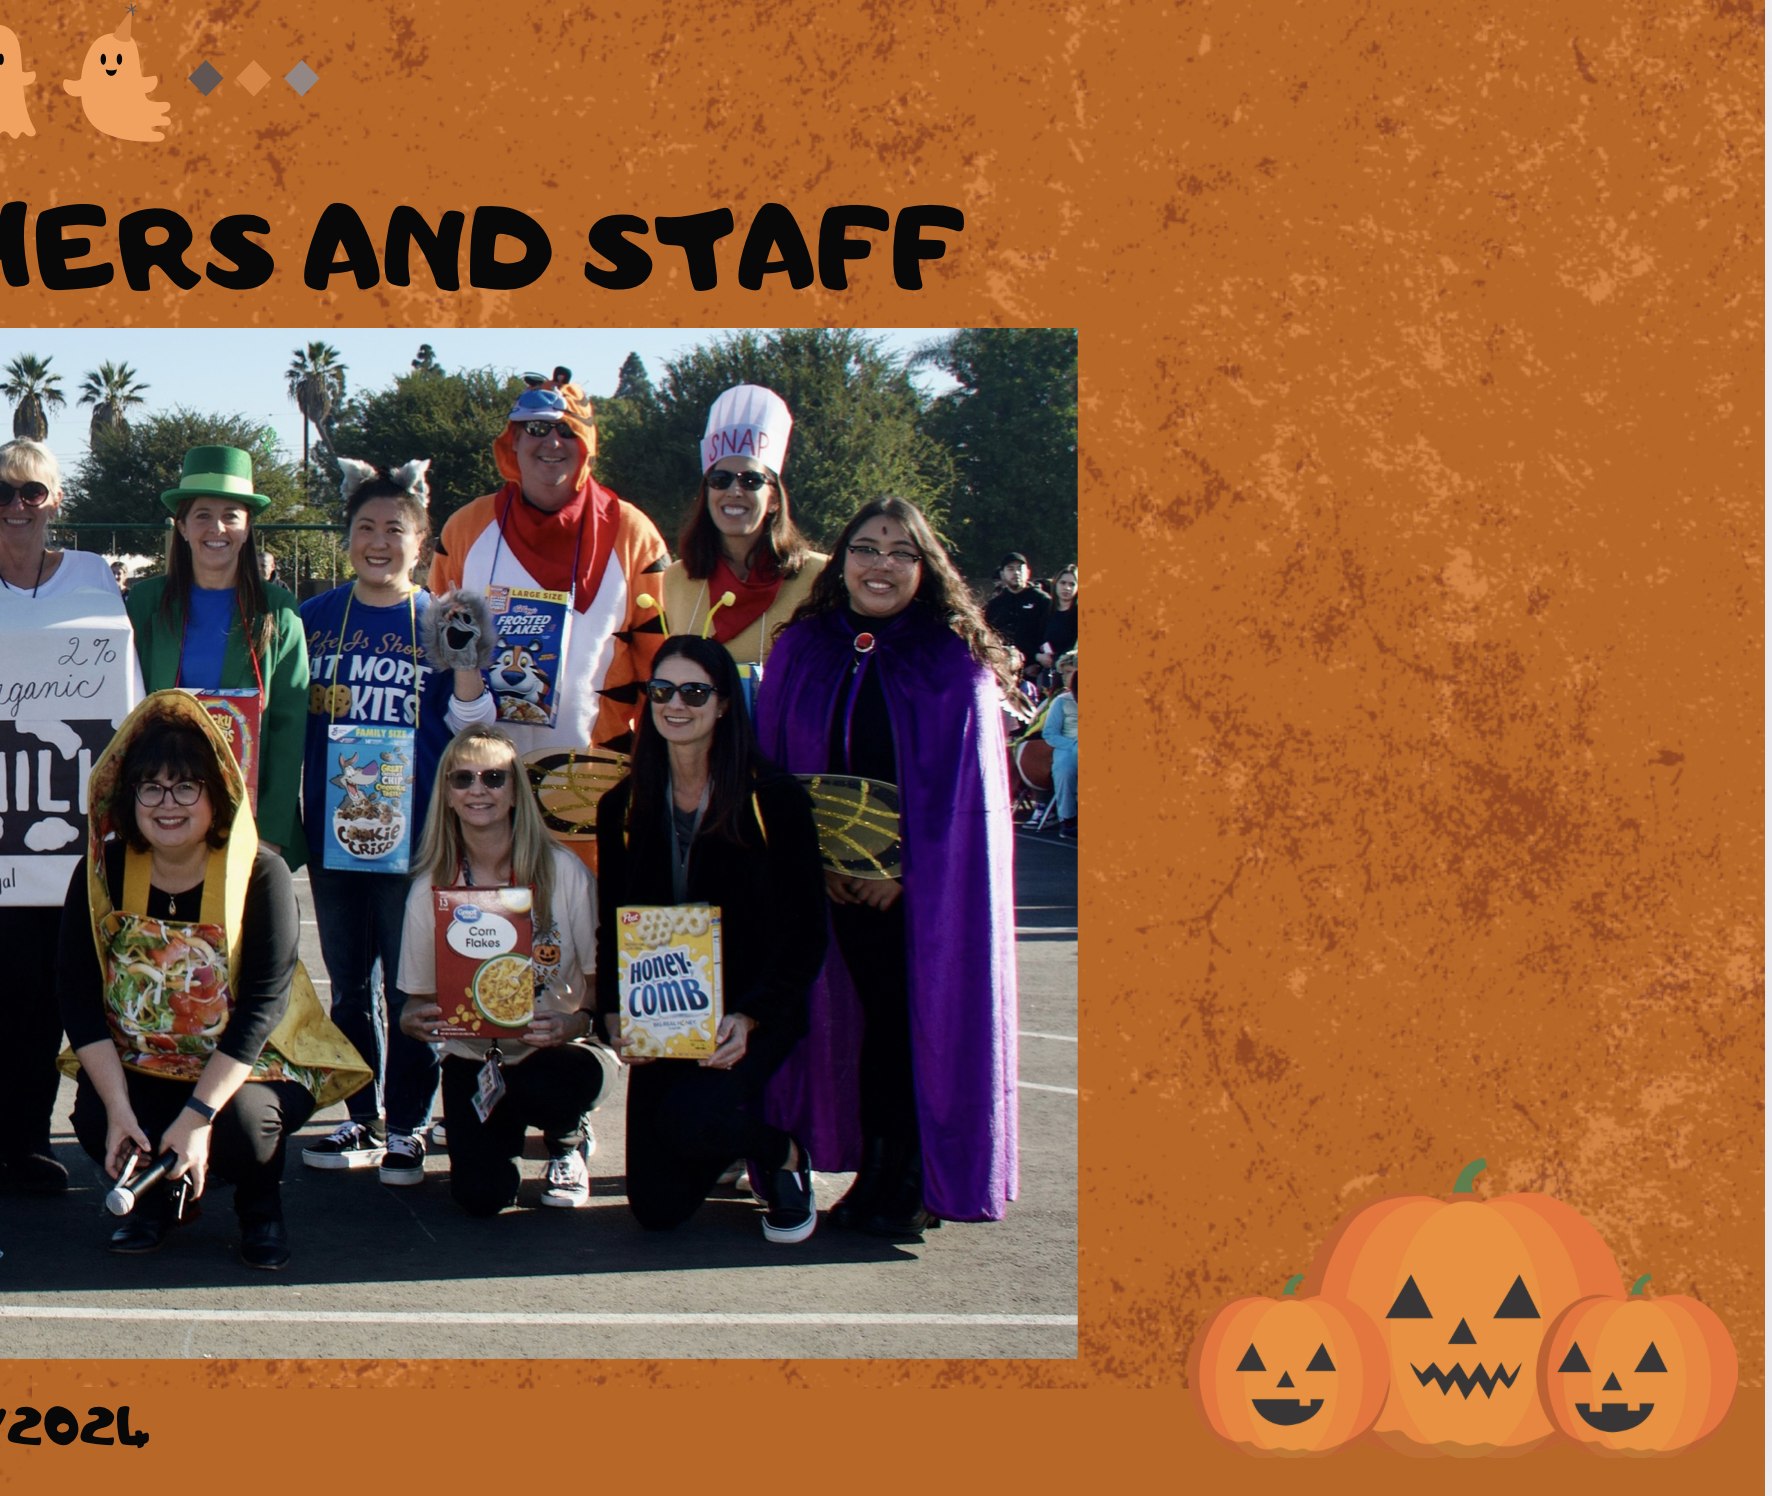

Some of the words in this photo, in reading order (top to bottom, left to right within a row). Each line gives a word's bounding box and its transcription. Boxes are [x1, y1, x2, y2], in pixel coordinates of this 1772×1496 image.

[709, 429, 769, 462] SNAP
[512, 590, 541, 598] LARGE
[496, 615, 552, 625] FROSTED
[498, 625, 546, 635] FLAKES
[343, 630, 369, 652] Is
[375, 633, 428, 658] Shor
[307, 654, 344, 680] AT
[349, 654, 433, 692] MORE
[212, 714, 232, 730] cky
[355, 728, 386, 738] FAMILY
[388, 730, 407, 738] SIZE
[382, 776, 403, 784] CHIP
[469, 926, 496, 936] Corn
[466, 938, 500, 948] Flakes
